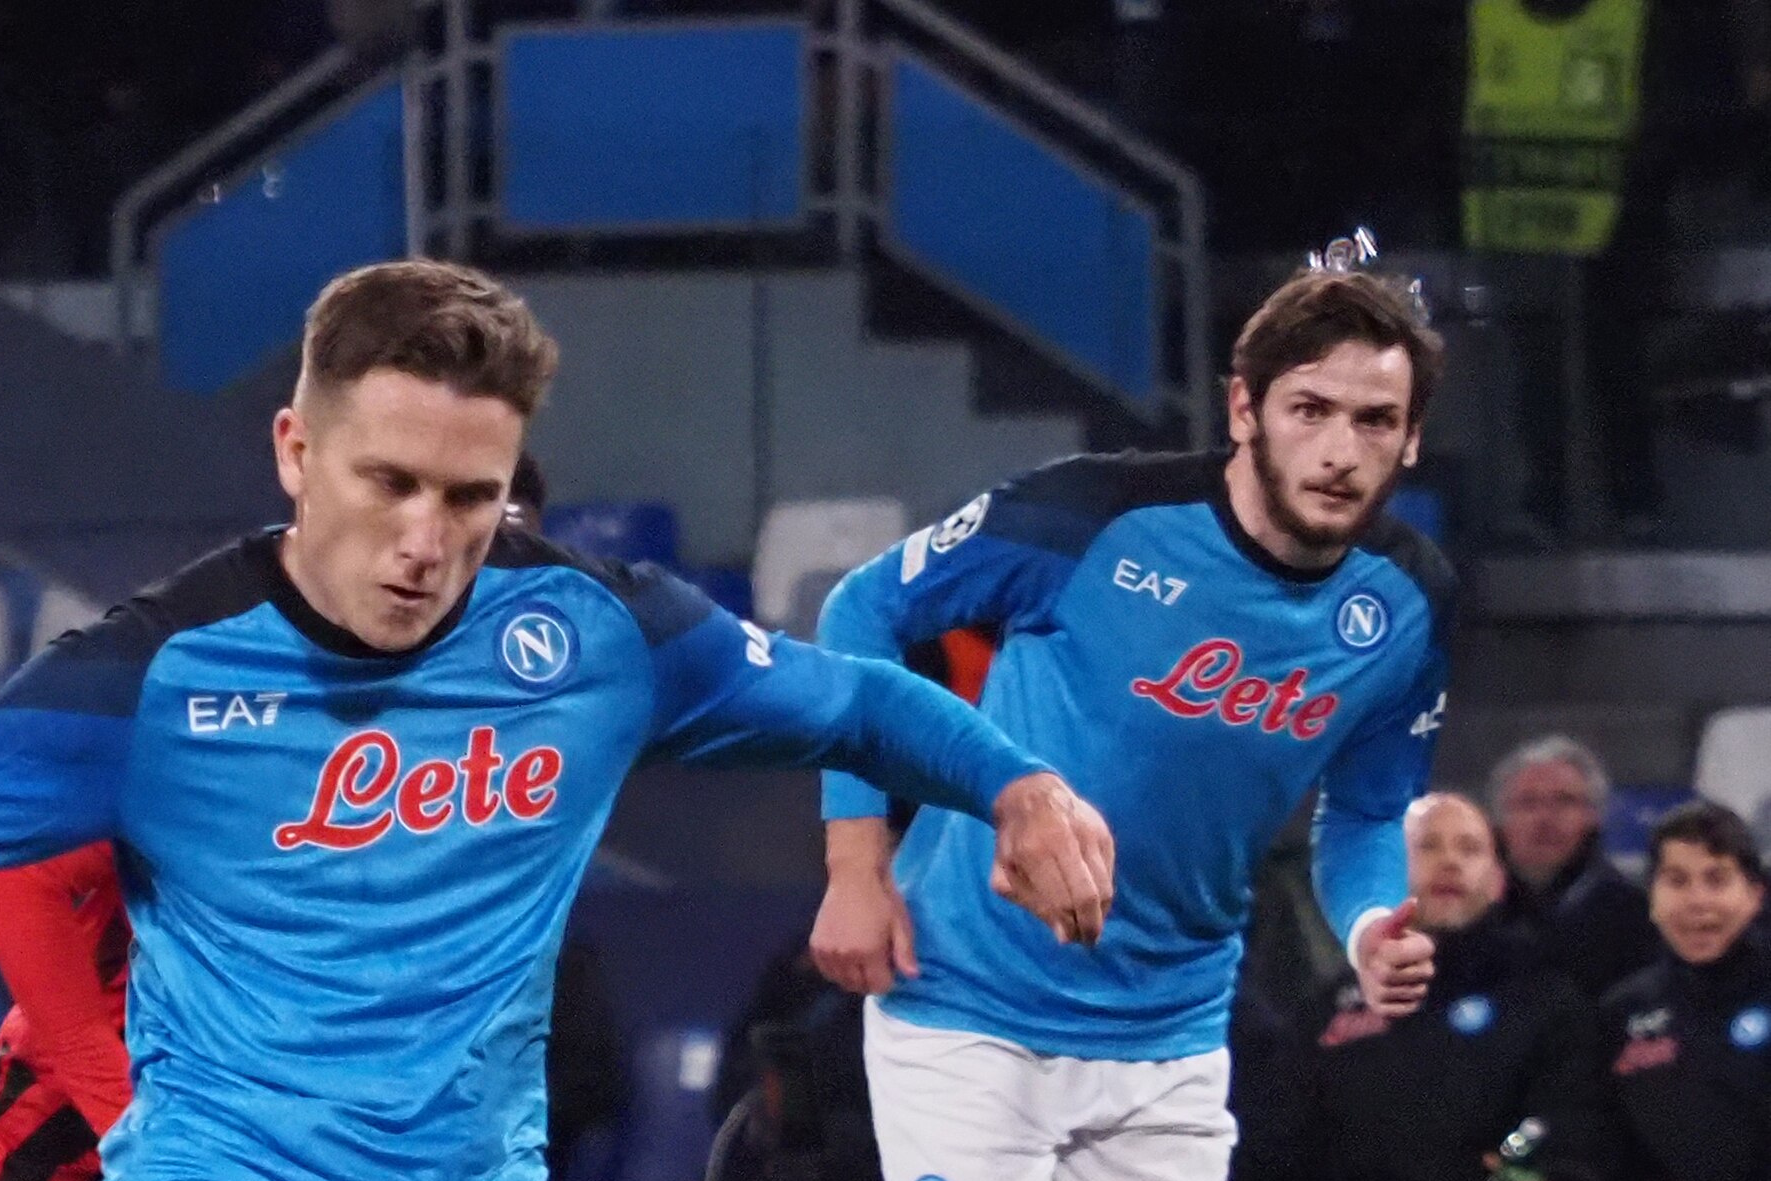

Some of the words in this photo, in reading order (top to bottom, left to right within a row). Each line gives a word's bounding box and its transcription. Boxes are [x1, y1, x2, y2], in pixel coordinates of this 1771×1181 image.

[1113, 559, 1188, 605] EA7
[512, 624, 555, 670] N
[1131, 637, 1340, 741] Lete
[187, 692, 288, 733] EA7
[272, 725, 562, 850] Lete
